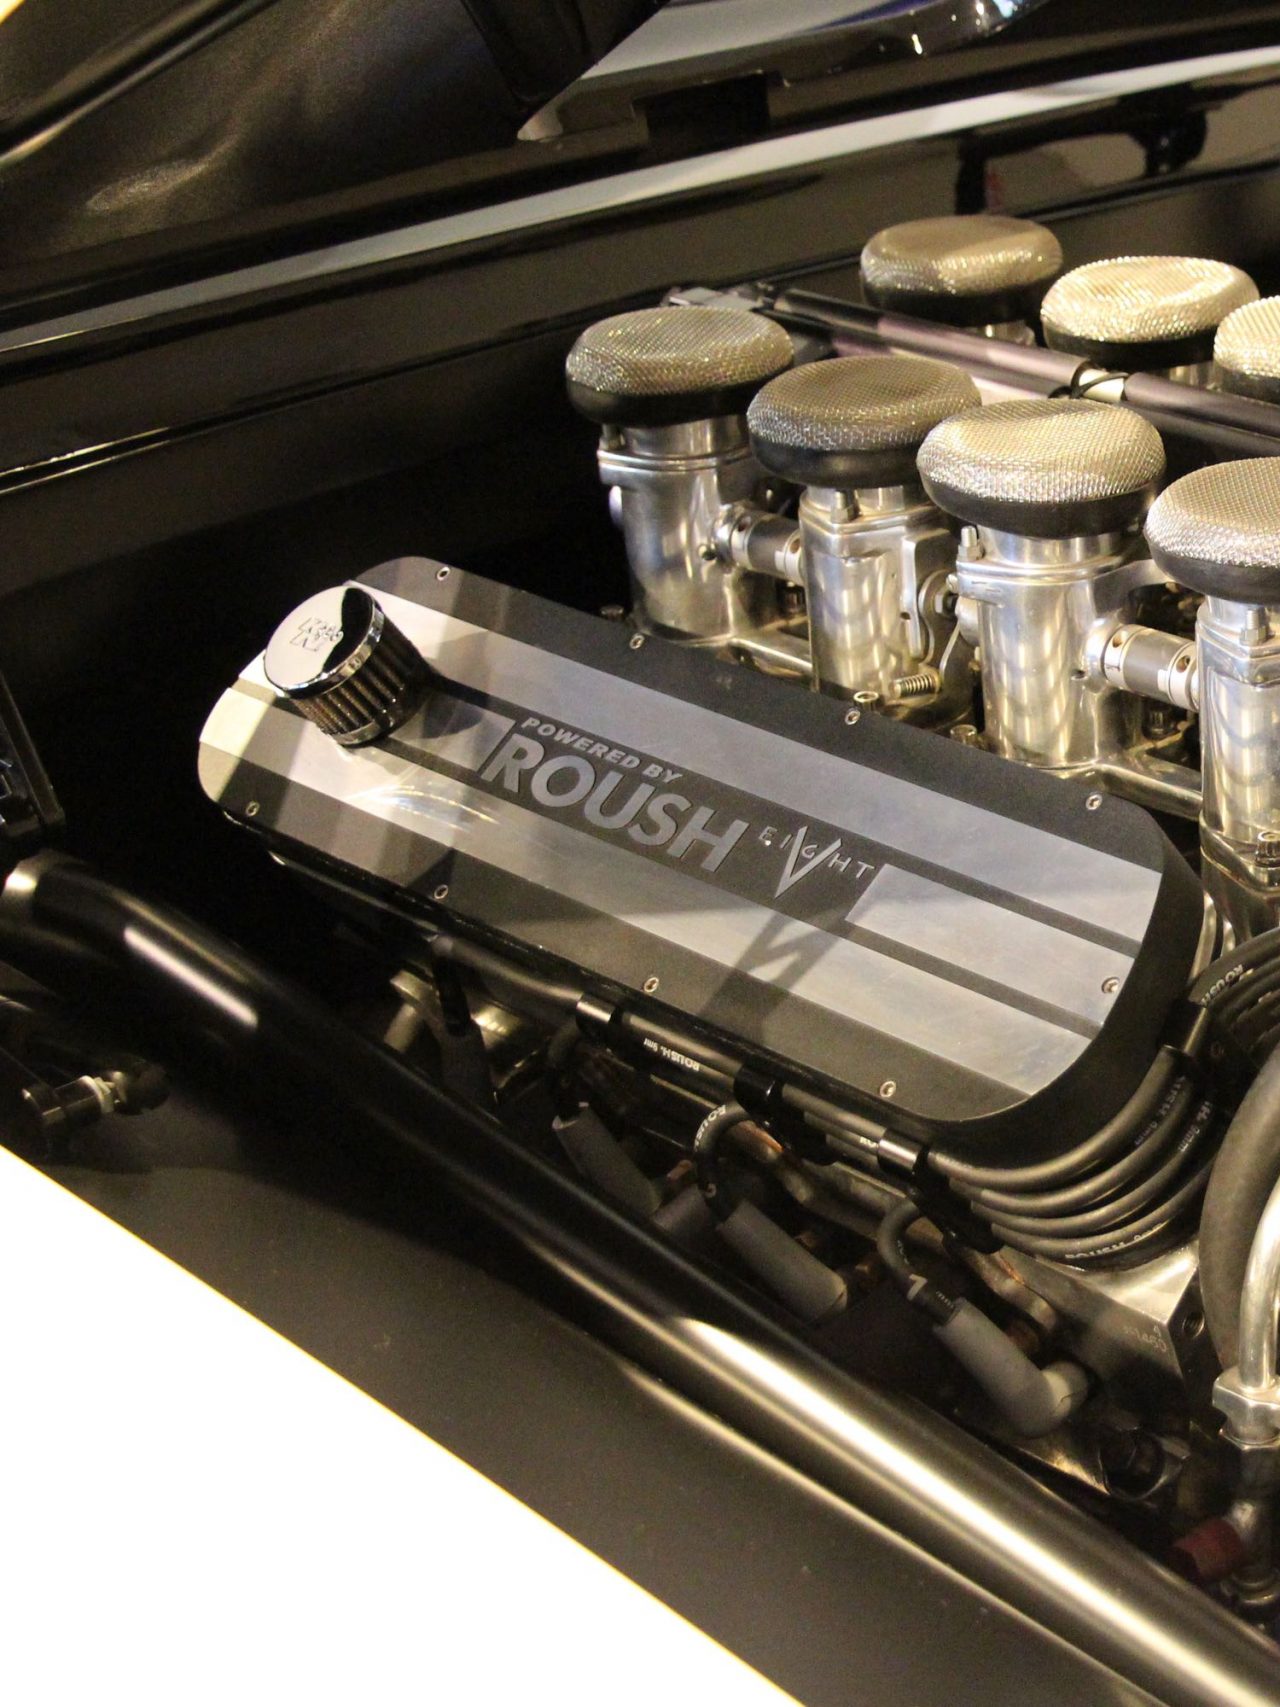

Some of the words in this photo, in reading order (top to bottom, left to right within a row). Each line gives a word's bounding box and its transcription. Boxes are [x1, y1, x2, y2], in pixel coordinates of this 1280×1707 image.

[521, 717, 641, 770] POWERED
[642, 763, 683, 784] BY
[480, 733, 751, 874] ROUSH
[758, 826, 875, 881] EIGHT
[662, 1048, 700, 1072] ROUSH
